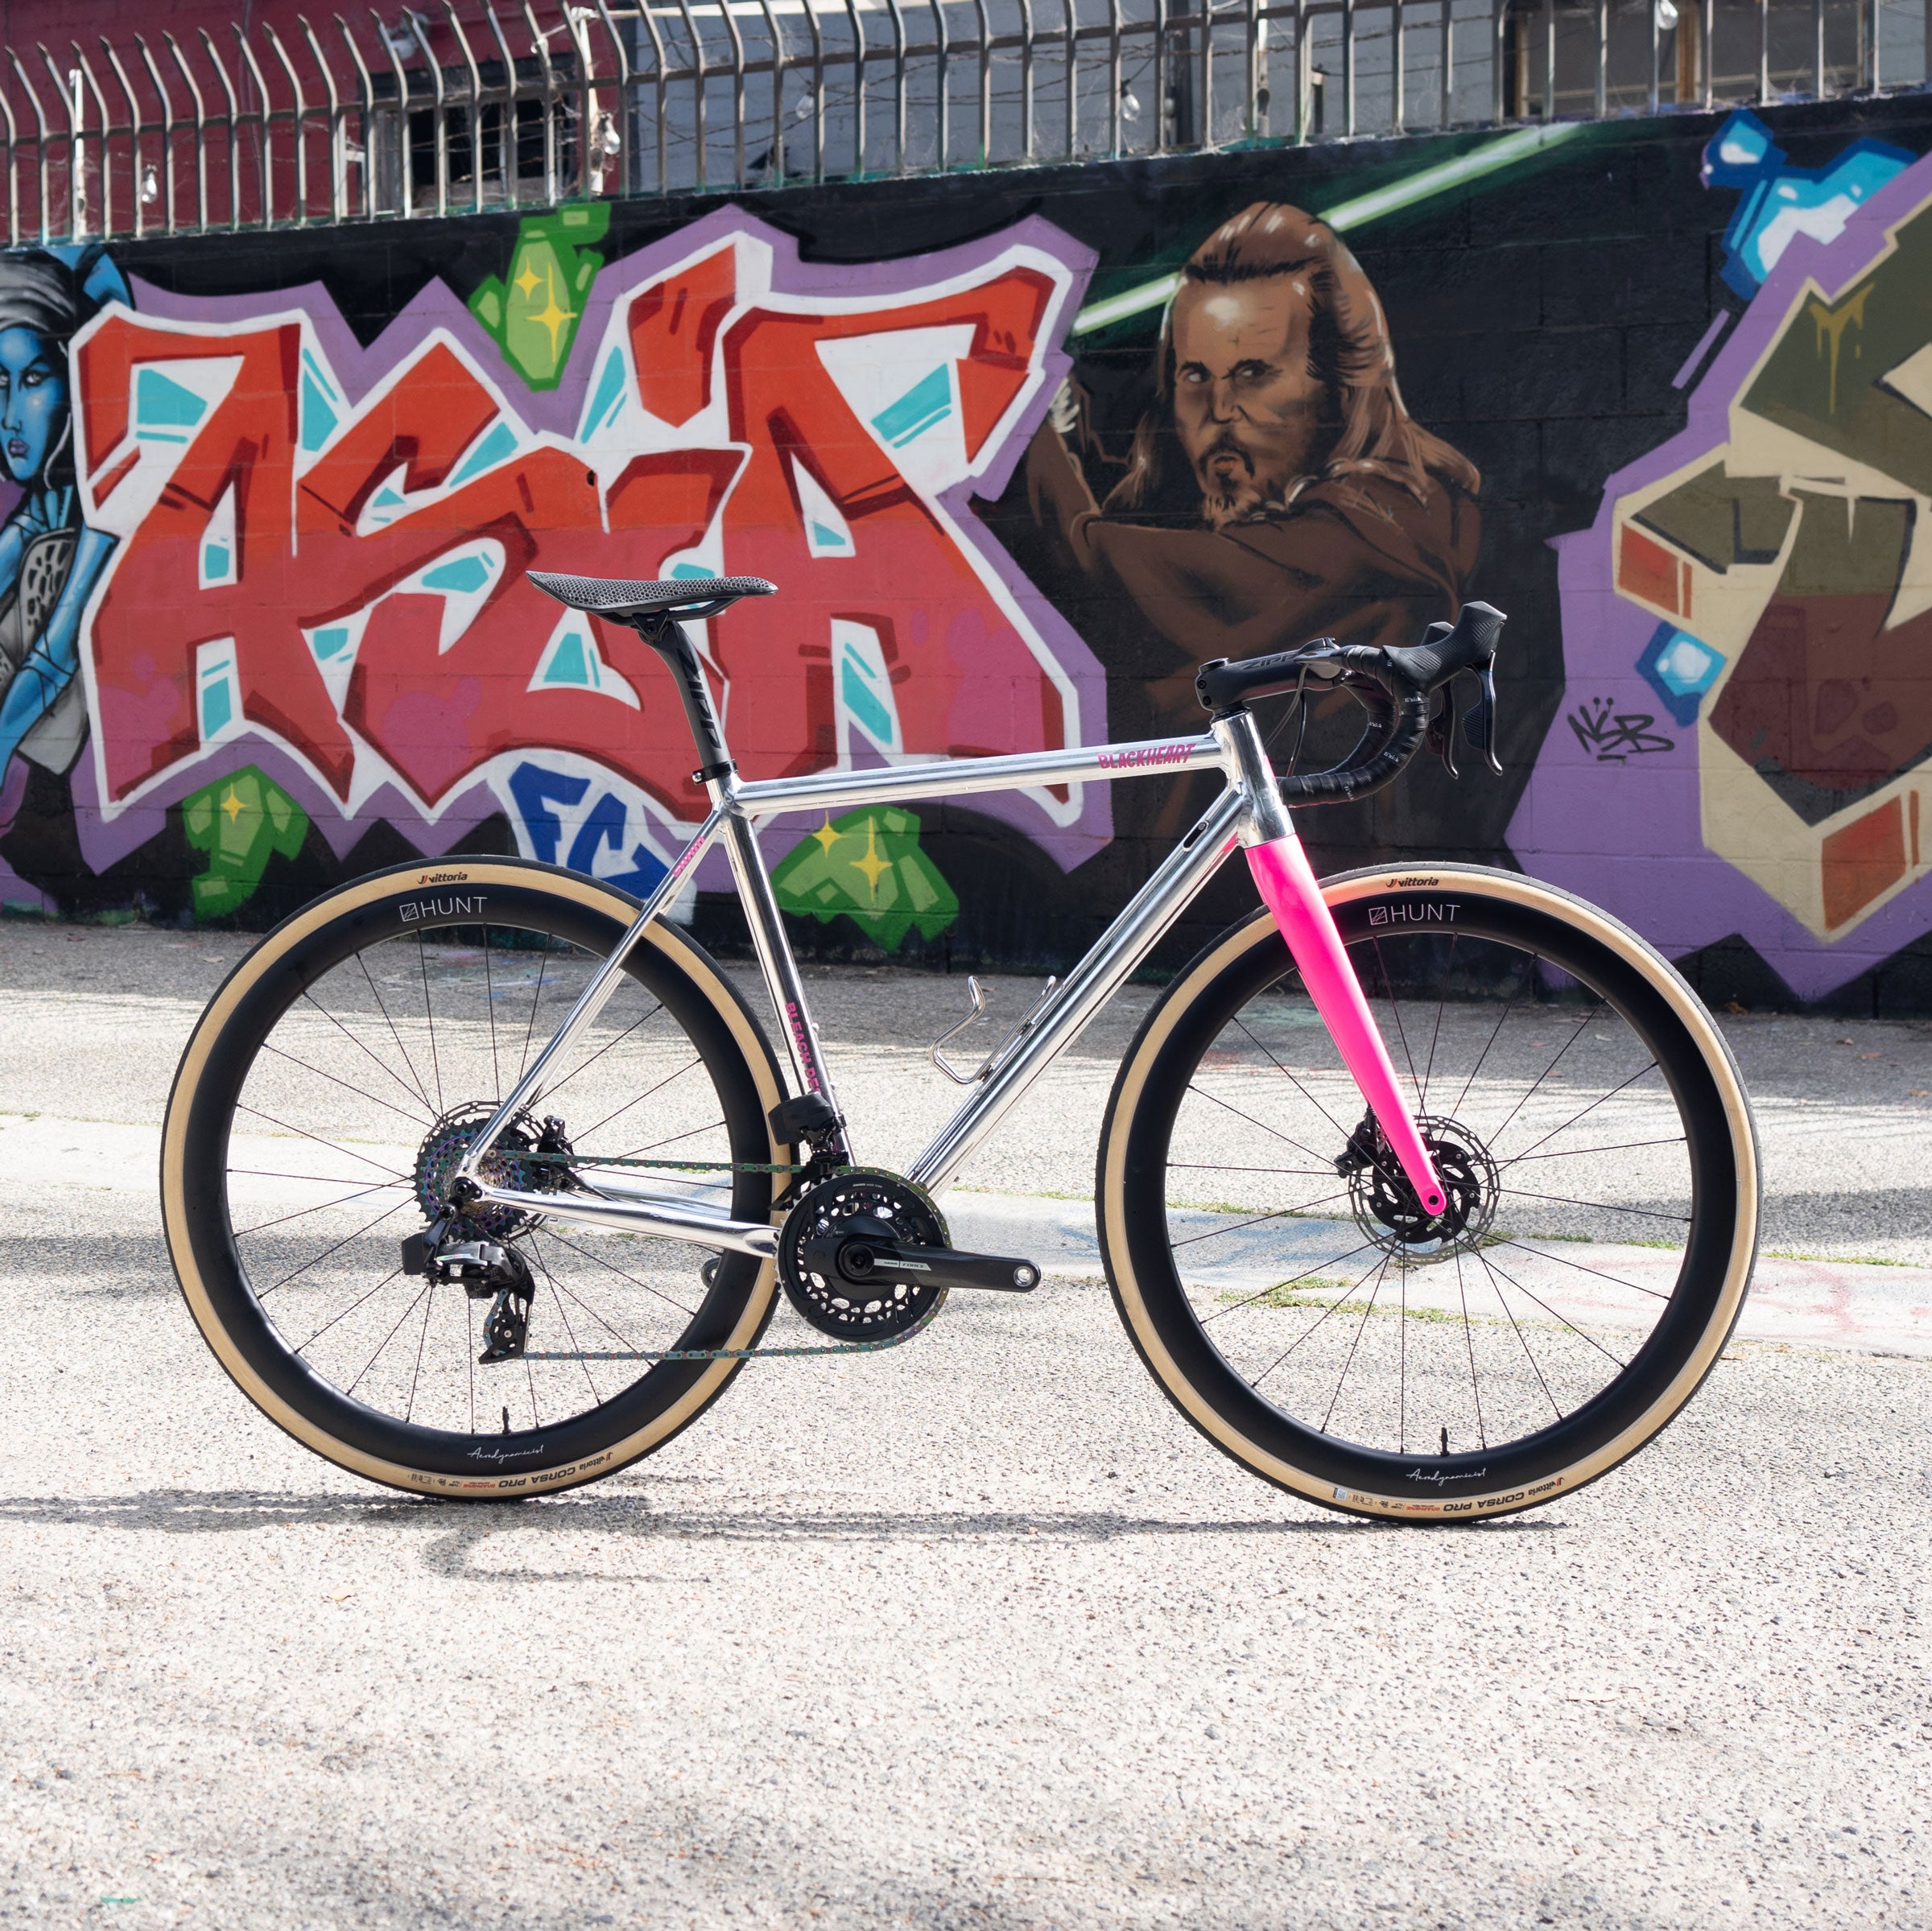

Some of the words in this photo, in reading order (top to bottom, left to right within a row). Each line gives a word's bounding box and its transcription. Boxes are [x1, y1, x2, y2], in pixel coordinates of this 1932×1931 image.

[676, 647, 722, 749] ZIPP
[1097, 742, 1197, 770] BLACKHEART
[428, 872, 468, 883] vittoria
[1397, 877, 1439, 887] vittoria
[419, 897, 488, 918] HUNT
[1390, 904, 1461, 922] HUNT
[785, 1001, 812, 1064] BLEACH
[579, 1453, 606, 1471] vittoria
[498, 1478, 527, 1488] PRO
[531, 1467, 576, 1485] CORSA
[1406, 1468, 1488, 1487] Aerodynamicist
[1528, 1480, 1558, 1497] vittoria
[1443, 1501, 1472, 1512] PRO
[1478, 1492, 1525, 1509] CORSA
